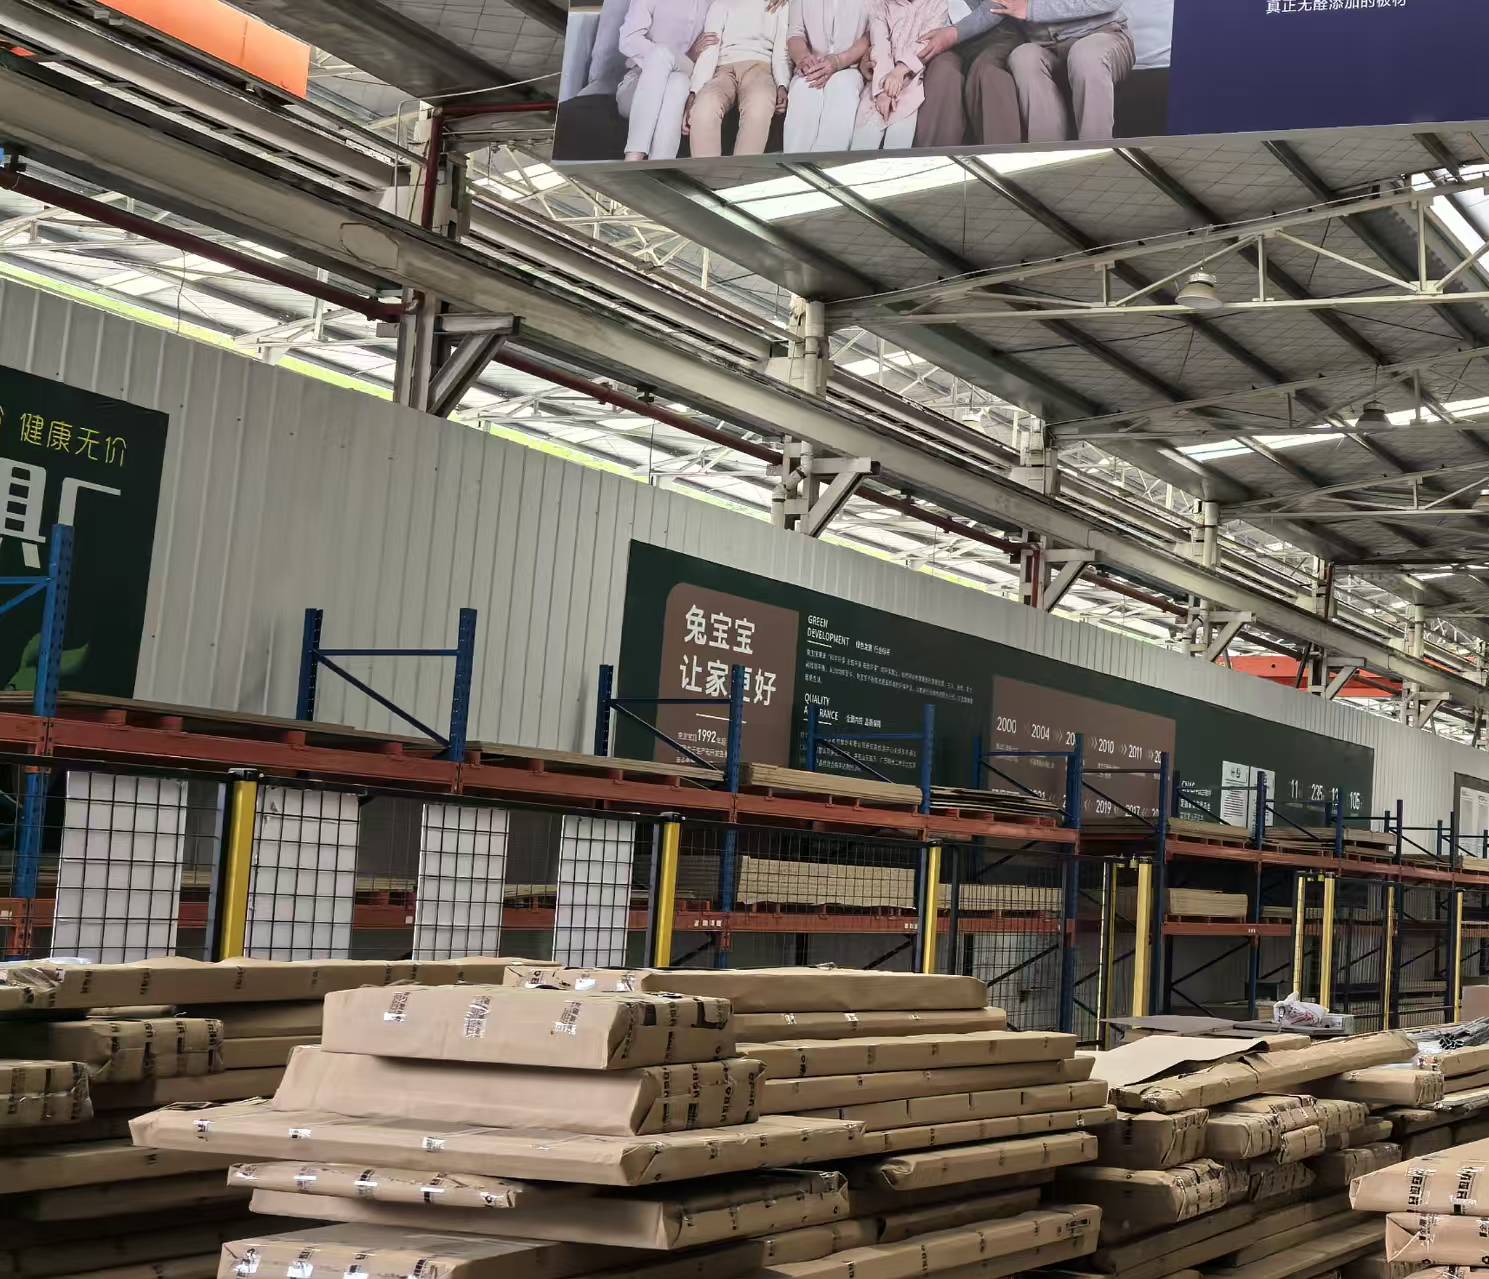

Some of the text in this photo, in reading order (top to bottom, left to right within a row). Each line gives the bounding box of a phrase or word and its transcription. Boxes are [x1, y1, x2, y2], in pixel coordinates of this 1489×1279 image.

[20, 413, 127, 467] 健康无价
[684, 604, 755, 655] 兔宝宝
[808, 615, 828, 629] GREEN
[807, 627, 850, 646] DEVELOPMENT
[805, 693, 830, 706] QUALITY
[804, 705, 839, 721] ARANCE
[996, 716, 1017, 734] 2000
[1031, 723, 1050, 740] 2004
[1066, 731, 1076, 746] 20
[1098, 738, 1115, 753] 2010
[1128, 744, 1143, 760] 2011
[1096, 800, 1112, 814] 2019
